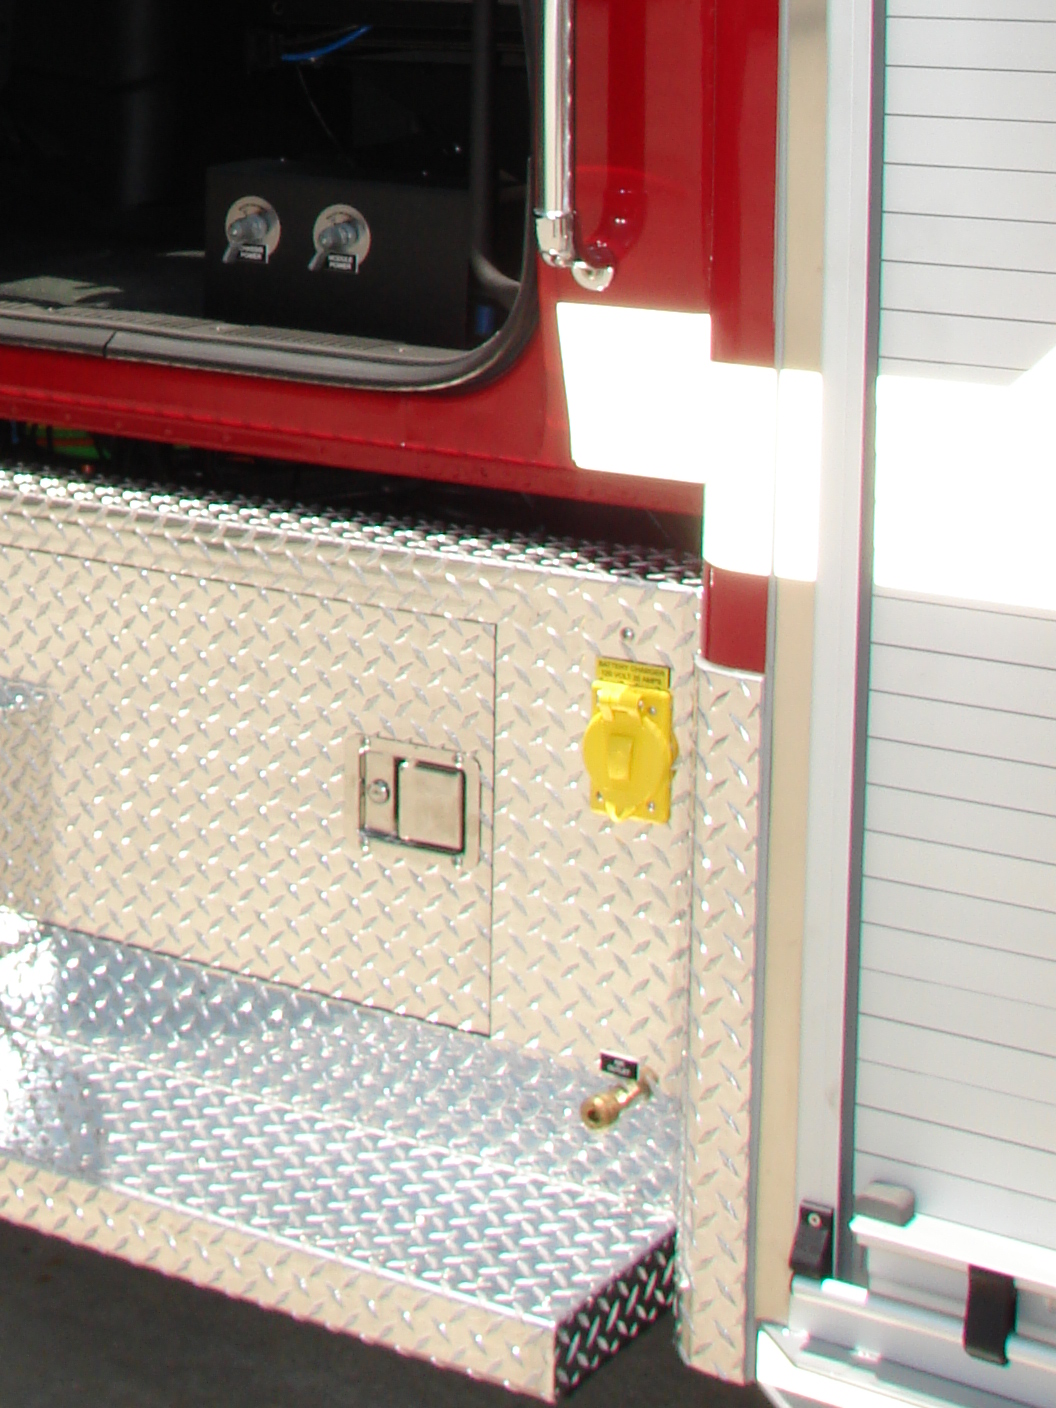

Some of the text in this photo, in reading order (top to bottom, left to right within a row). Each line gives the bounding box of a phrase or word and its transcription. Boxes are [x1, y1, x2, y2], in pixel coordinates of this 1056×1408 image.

[598, 659, 665, 677] BATTERY CHARGER
[614, 671, 631, 680] VOLT
[642, 676, 662, 686] AMPS
